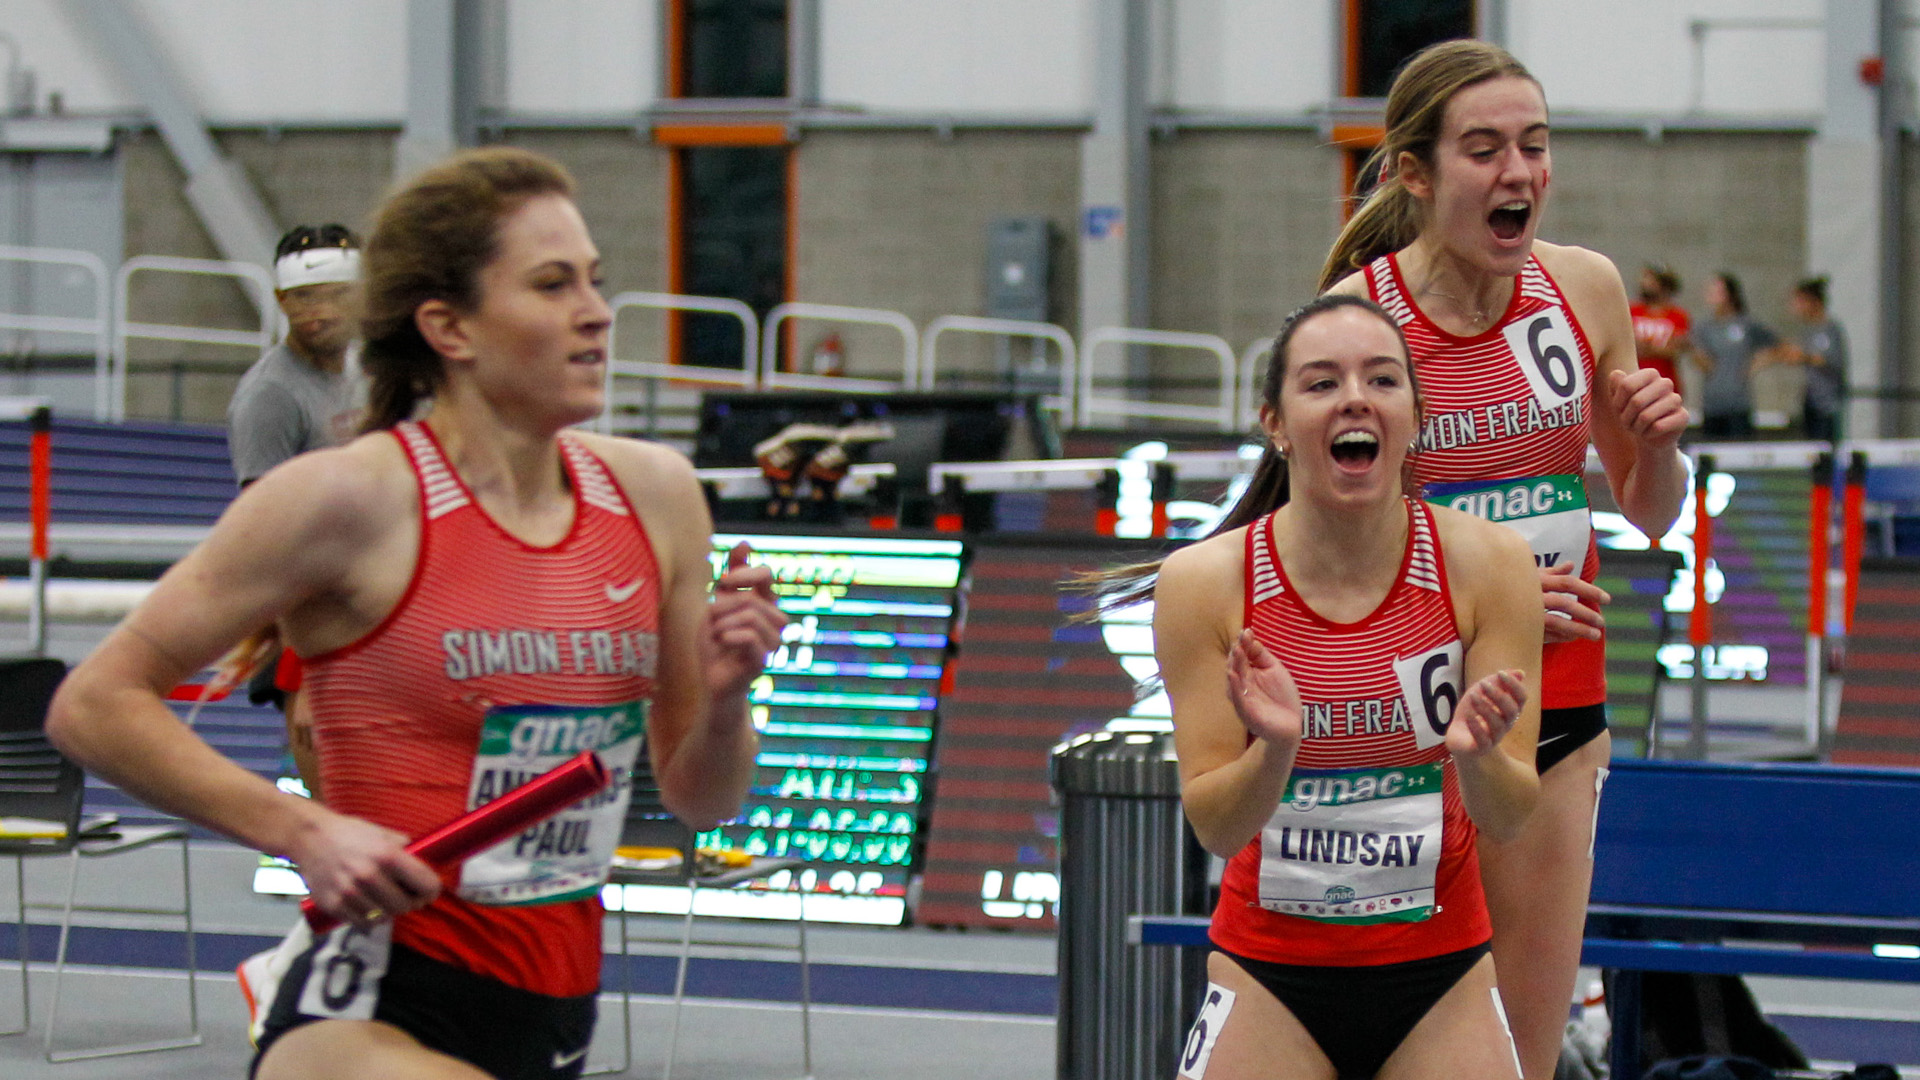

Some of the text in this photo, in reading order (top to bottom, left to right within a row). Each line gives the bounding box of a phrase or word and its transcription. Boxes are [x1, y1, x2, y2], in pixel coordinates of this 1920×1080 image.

[1527, 316, 1577, 398] 6
[443, 629, 561, 681] SIMON
[1346, 697, 1410, 736] FRA
[1420, 652, 1458, 737] 6
[508, 709, 627, 764] gnac
[1290, 770, 1405, 812] gnac
[515, 819, 592, 857] PAUL
[1280, 826, 1426, 868] LINDSAY
[1325, 889, 1356, 904] gnac
[1184, 989, 1223, 1072] 6
